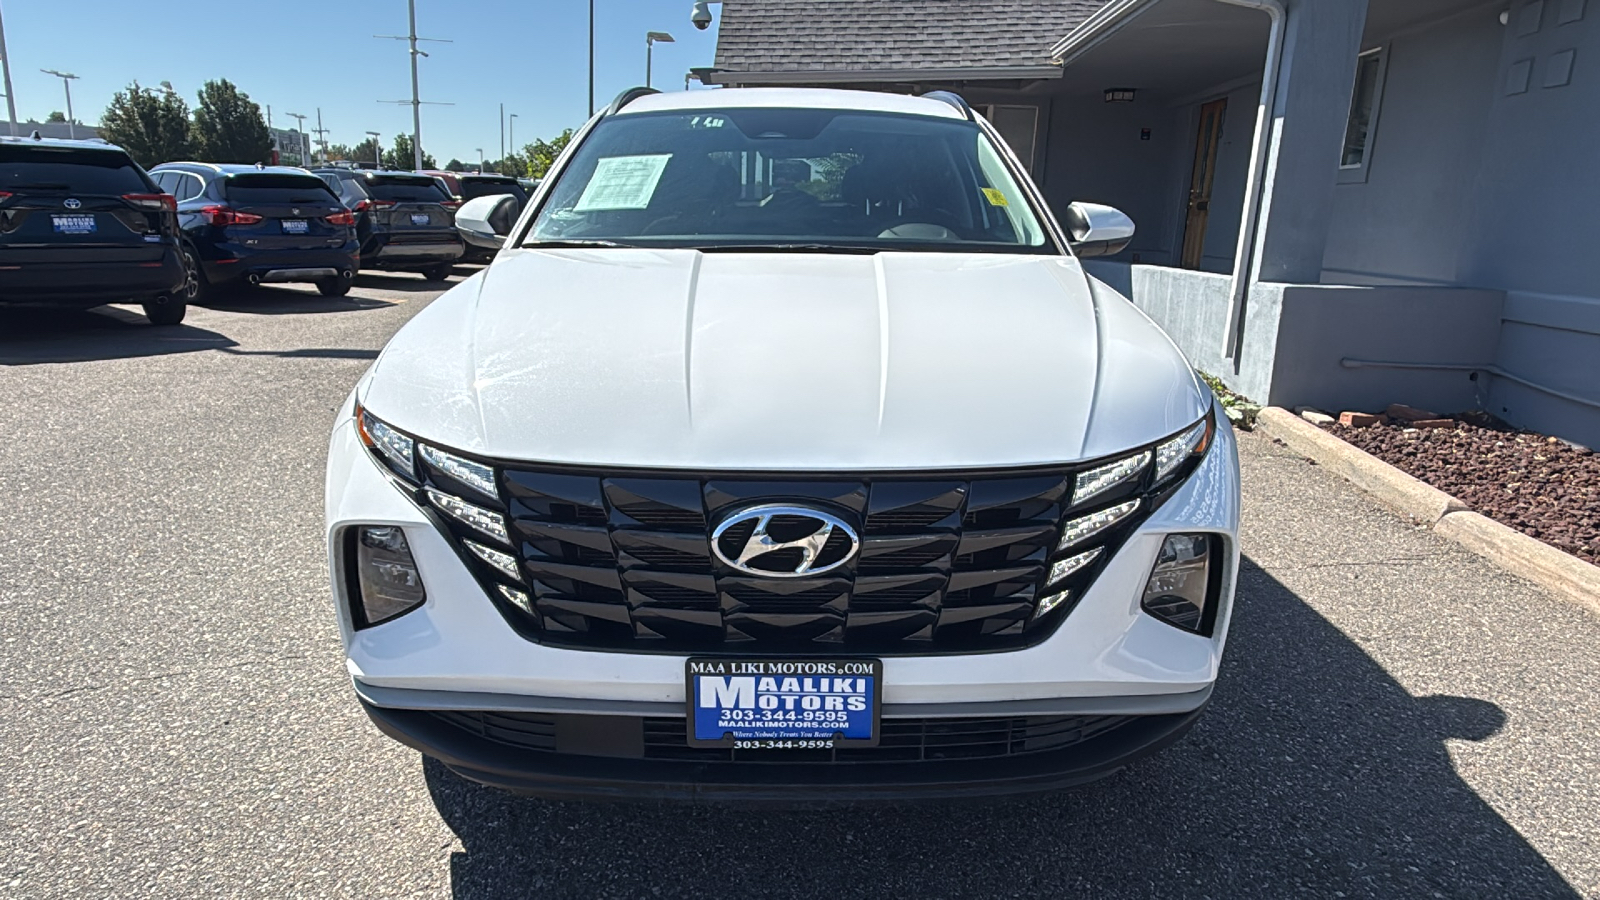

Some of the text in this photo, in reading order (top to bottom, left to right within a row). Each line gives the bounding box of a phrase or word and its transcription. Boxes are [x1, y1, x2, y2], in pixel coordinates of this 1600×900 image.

[731, 663, 765, 674] LIKI
[721, 709, 848, 721] 303-344-9595
[718, 720, 849, 729] MAALIKIMOTORS.COM
[753, 731, 778, 739] Nobody
[733, 740, 834, 749] 303-344-9595
